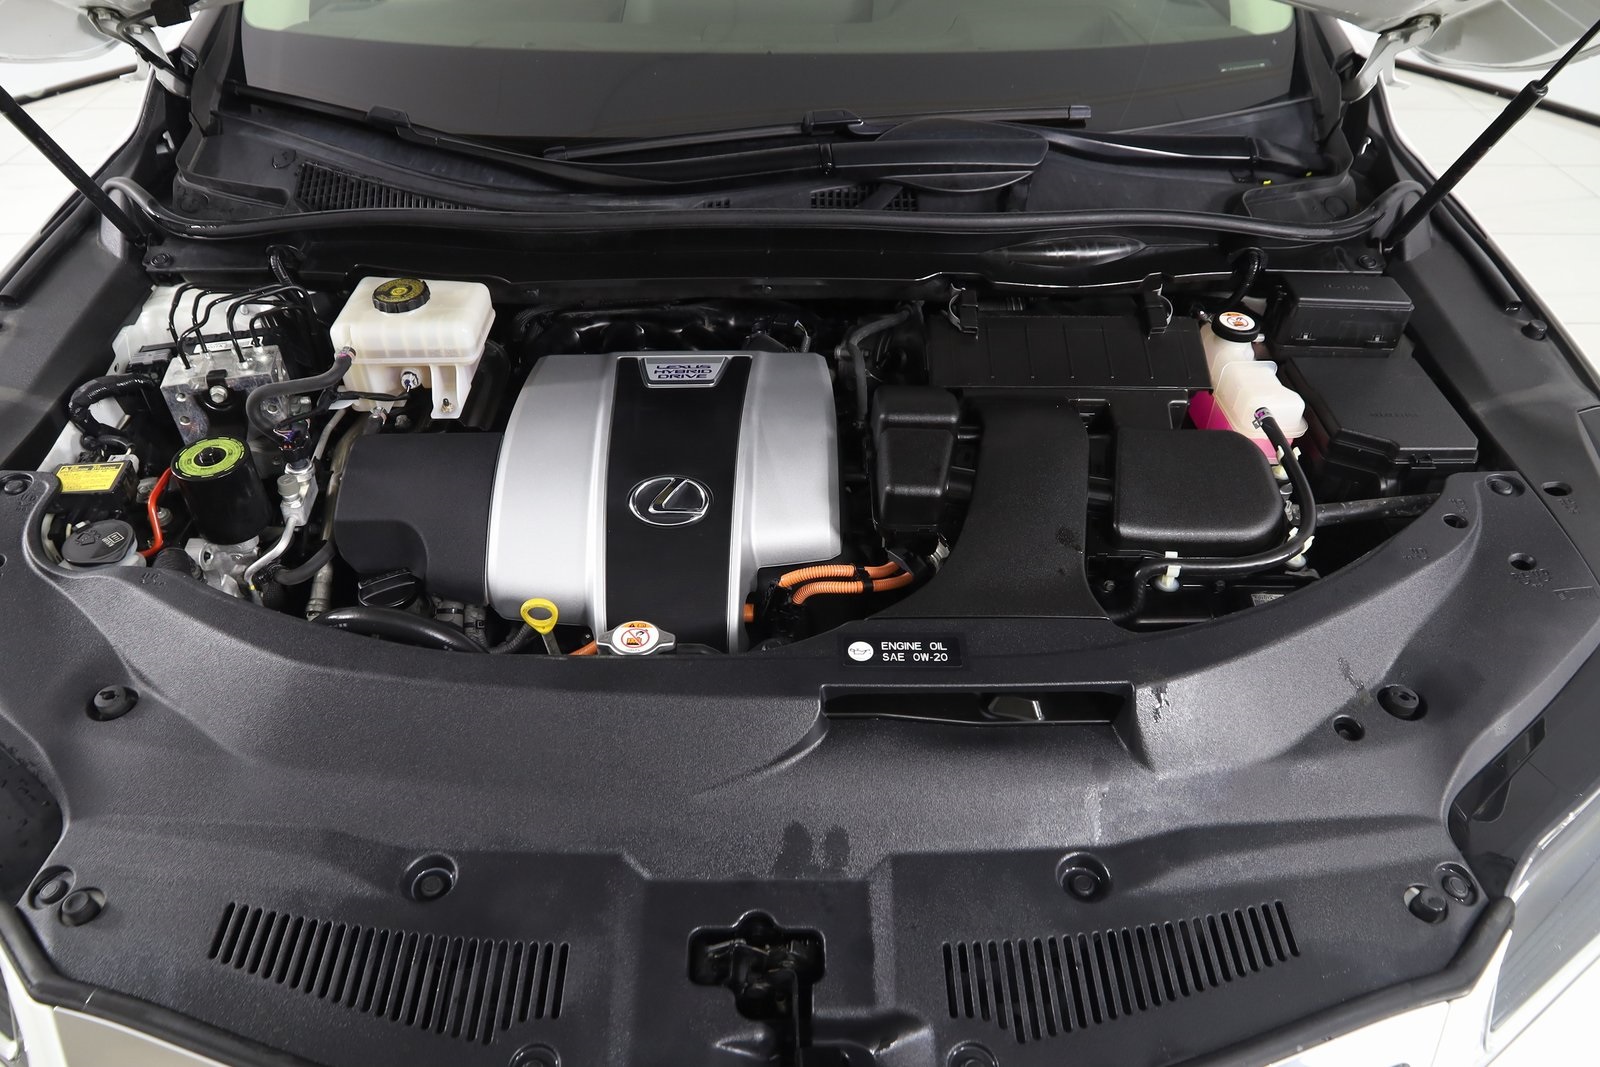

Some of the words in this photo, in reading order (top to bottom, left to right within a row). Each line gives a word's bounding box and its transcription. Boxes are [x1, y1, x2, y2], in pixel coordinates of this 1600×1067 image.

[881, 642, 922, 651] ENGINE
[929, 642, 948, 651] OIL
[882, 653, 905, 661] SAE
